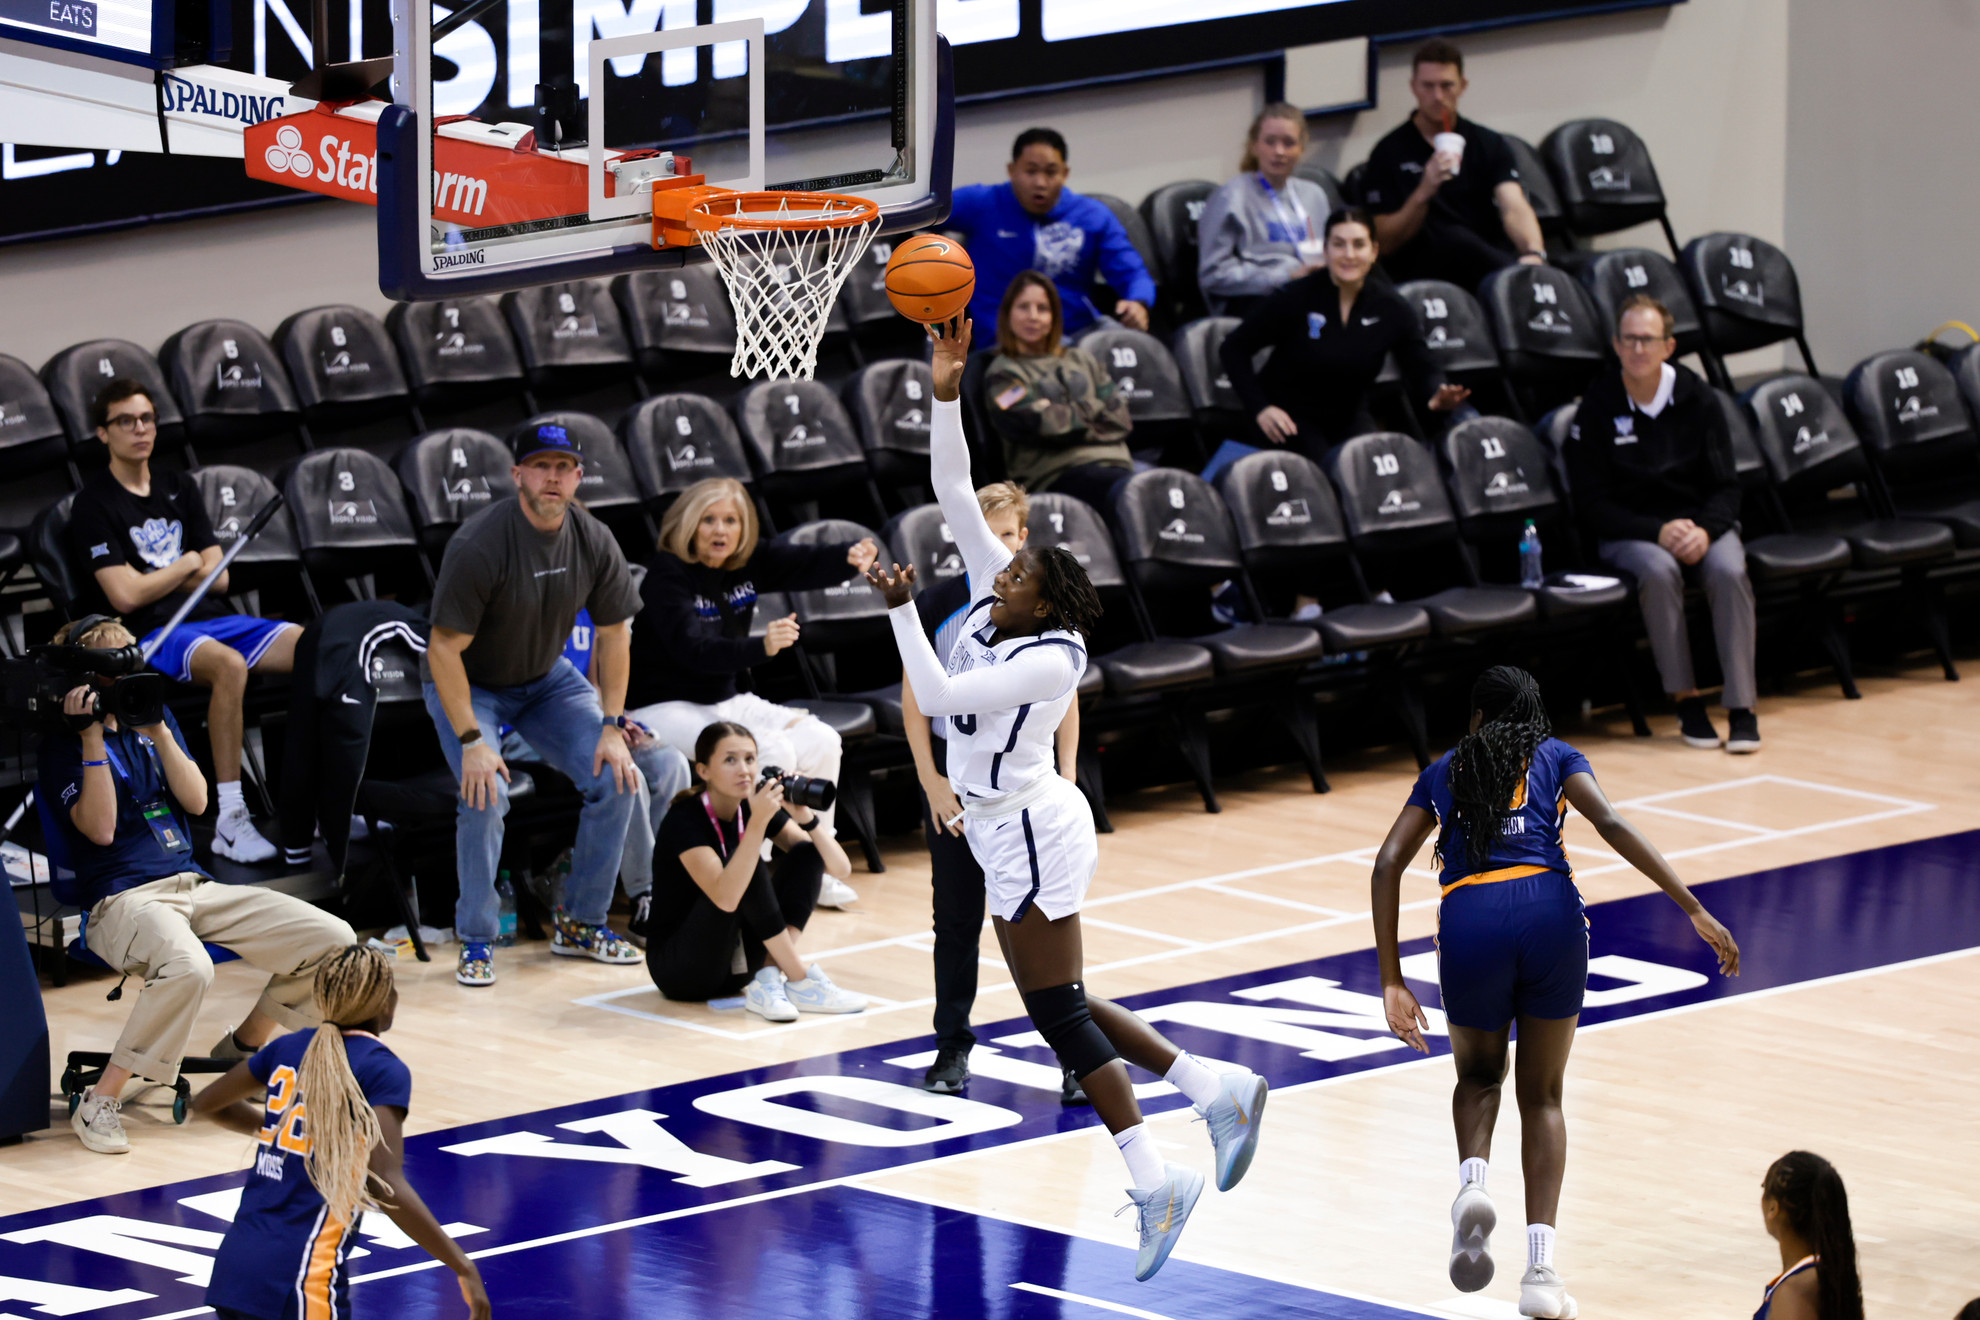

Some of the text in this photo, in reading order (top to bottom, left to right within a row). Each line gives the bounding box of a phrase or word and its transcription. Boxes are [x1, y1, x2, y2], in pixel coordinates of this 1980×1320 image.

[50, 2, 93, 29] EATS
[163, 72, 285, 125] SPALDING
[316, 135, 378, 195] Stat
[433, 249, 485, 271] SPALDING
[445, 308, 460, 328] 7
[331, 326, 347, 347] 6
[222, 339, 239, 359] 5
[1111, 347, 1138, 368] 10
[99, 358, 115, 378] 4
[905, 379, 923, 400] 8
[785, 394, 800, 415] 7
[675, 415, 692, 436] 6
[452, 448, 468, 468] 4
[1481, 437, 1506, 460] 11
[1372, 453, 1399, 476] 10
[338, 471, 355, 491] 3
[1271, 470, 1288, 492] 9
[220, 486, 236, 506] 2
[1168, 488, 1185, 509] 8
[1049, 513, 1064, 533] 7
